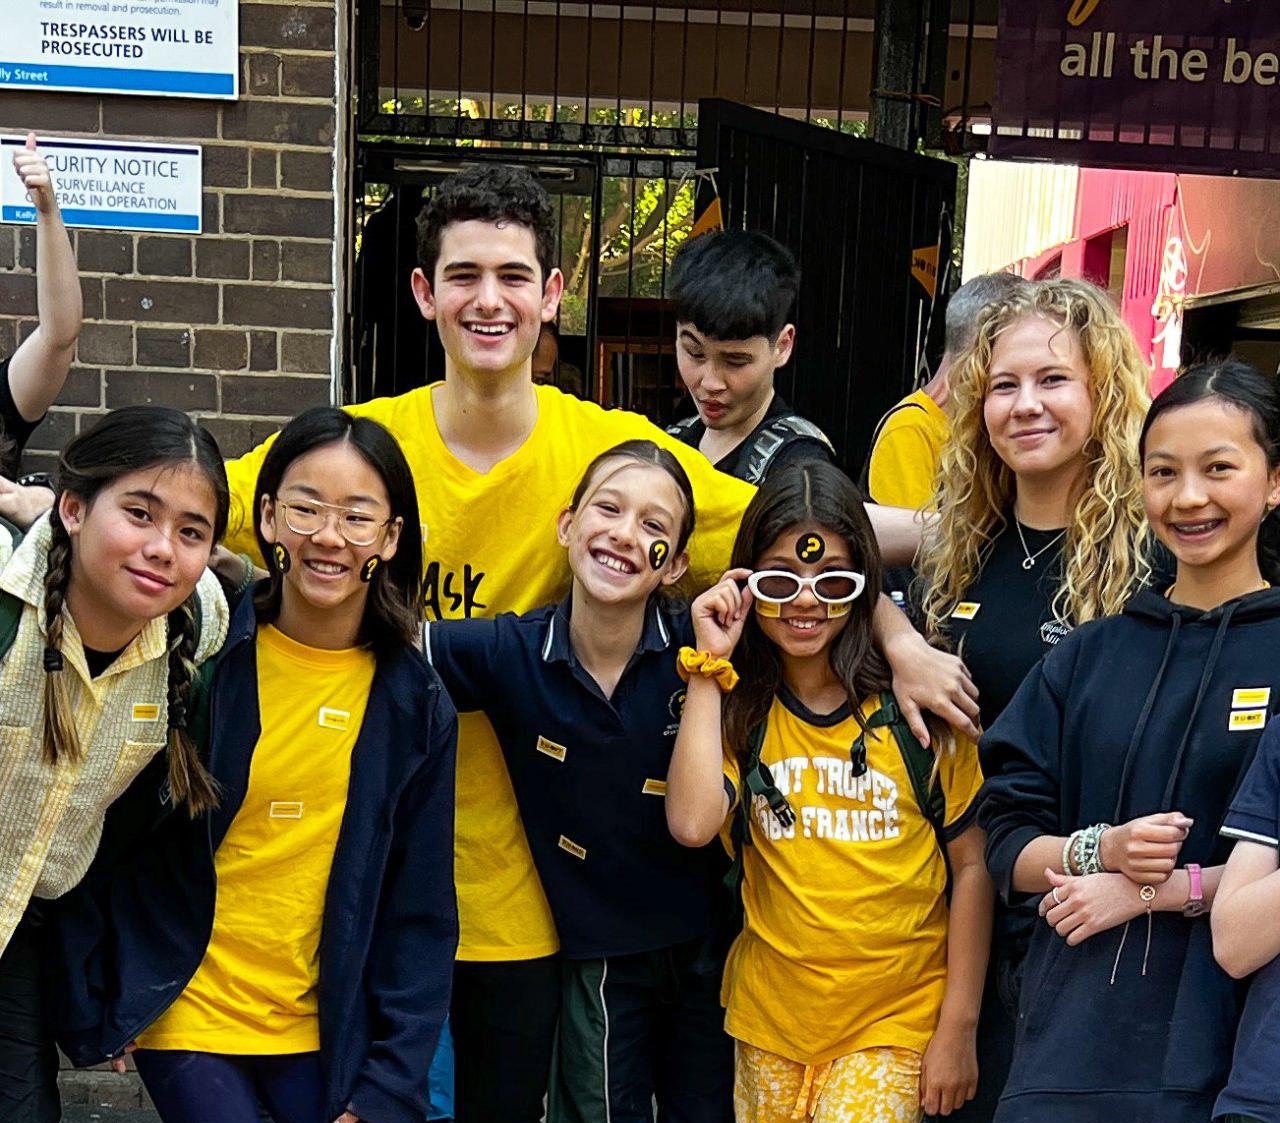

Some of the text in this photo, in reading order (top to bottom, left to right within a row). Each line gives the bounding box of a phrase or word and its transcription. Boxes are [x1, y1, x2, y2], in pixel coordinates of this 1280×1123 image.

[75, 3, 109, 12] removal
[112, 4, 128, 13] and
[41, 22, 213, 44] TRESPASSERS WILL BE
[41, 40, 144, 58] PROSECUTED
[1060, 32, 1116, 78] all
[1130, 35, 1208, 82] the
[14, 69, 48, 81] Street
[44, 154, 179, 178] CURITY NOTICE
[56, 178, 146, 194] SURVEILLANCE
[90, 194, 102, 207] IN
[106, 197, 177, 210] OPERATION
[15, 209, 36, 220] Kelly
[812, 757, 898, 810] TROPEZ
[801, 807, 899, 841] FRANCE
